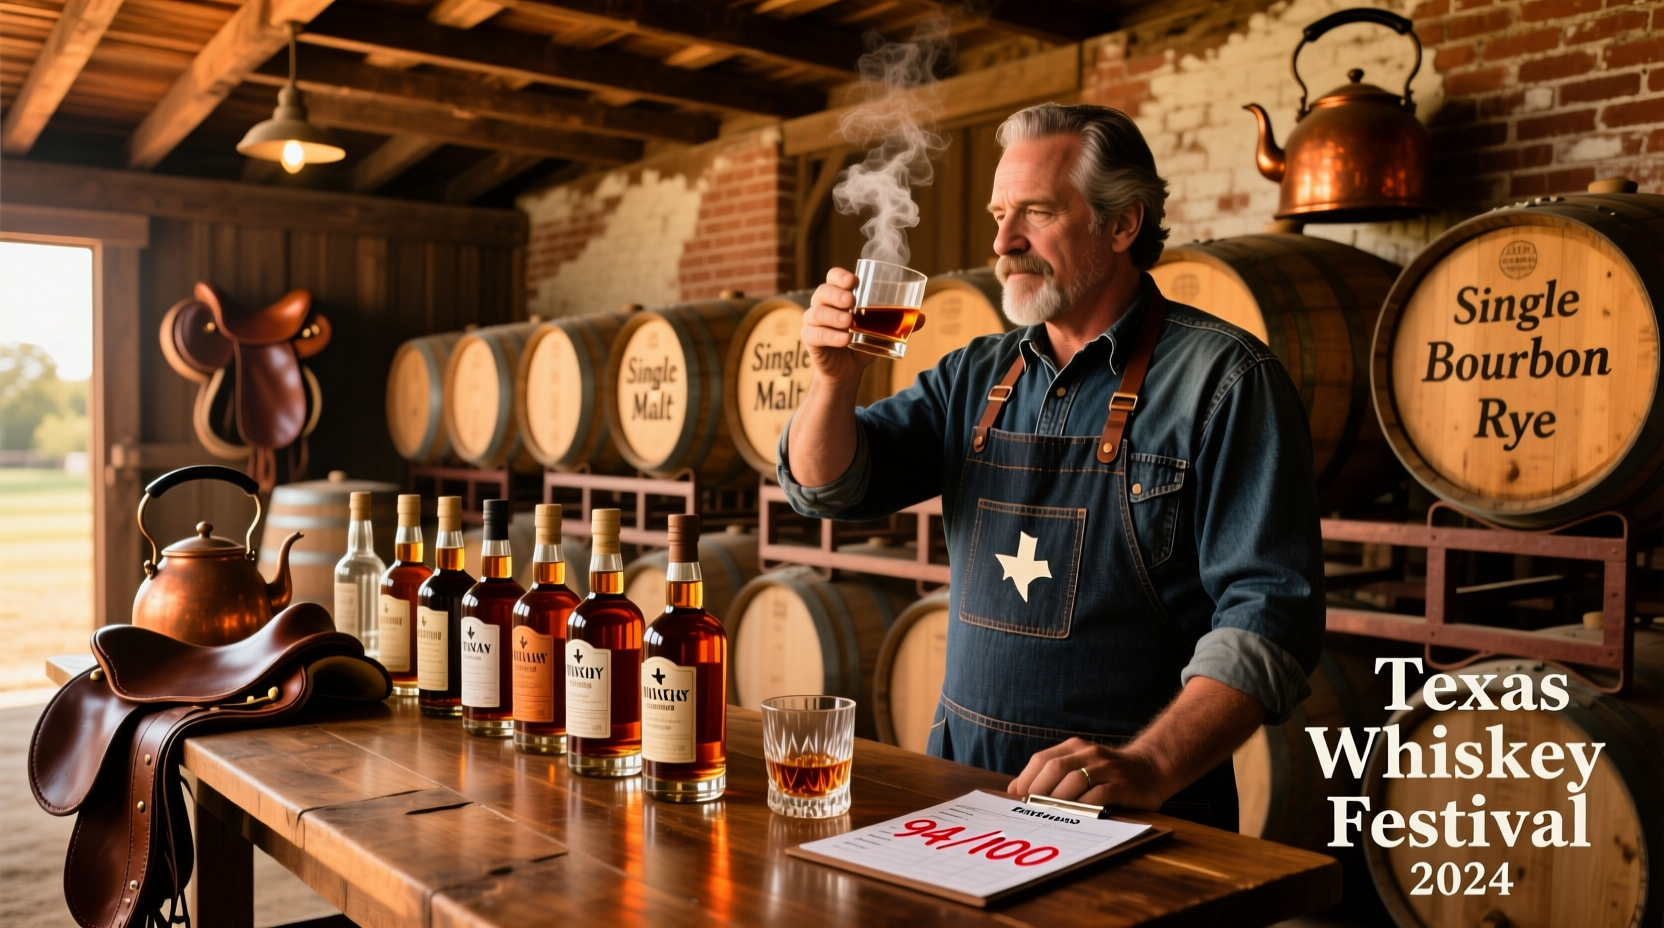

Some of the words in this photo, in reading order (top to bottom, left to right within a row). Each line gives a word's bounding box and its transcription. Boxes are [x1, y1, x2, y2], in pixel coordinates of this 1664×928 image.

[1454, 279, 1580, 332] Single
[627, 356, 678, 390] Single
[752, 340, 811, 377] Single
[1421, 336, 1612, 383] Bourbon
[631, 390, 674, 421] Malt
[754, 380, 805, 411] Malt
[1473, 397, 1556, 452] Rye
[893, 818, 1060, 867] 94/100
